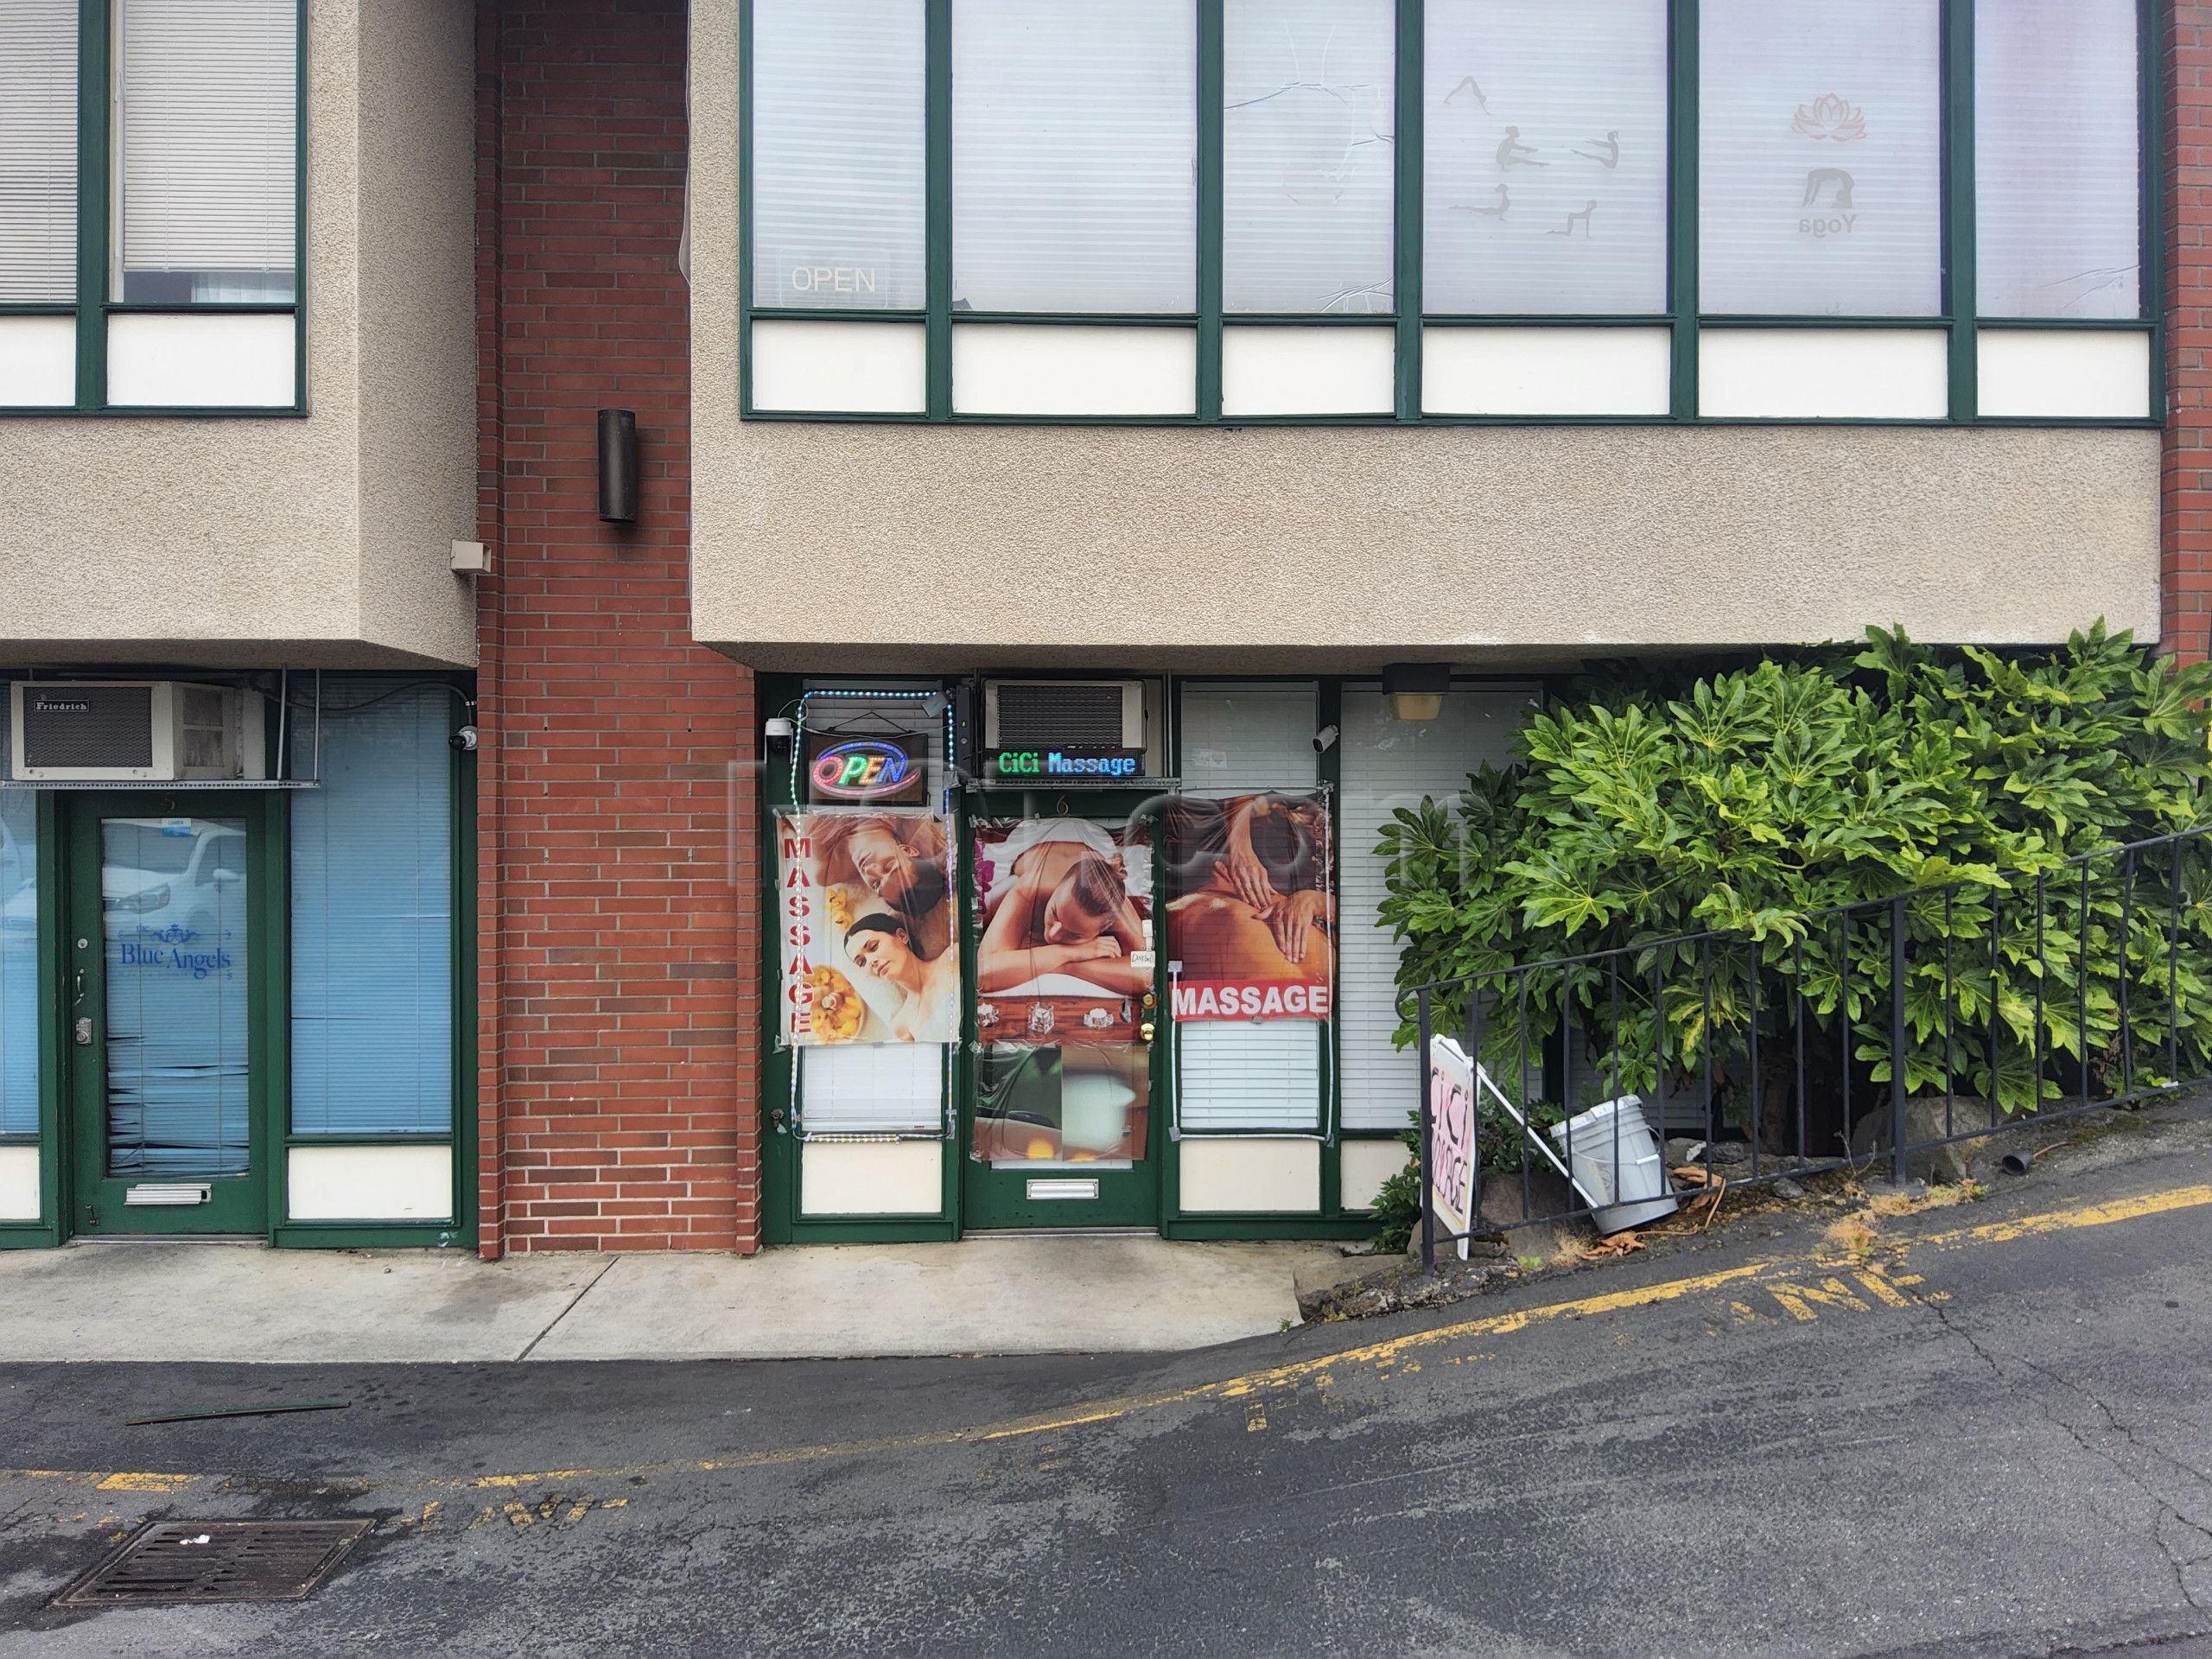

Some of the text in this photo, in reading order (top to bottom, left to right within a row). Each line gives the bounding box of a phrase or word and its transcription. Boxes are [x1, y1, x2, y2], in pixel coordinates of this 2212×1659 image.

[791, 265, 876, 292] OPEN
[35, 702, 87, 710] Friedrich
[813, 753, 904, 786] OPEN
[998, 752, 1135, 776] CiCi Massage
[1056, 794, 1069, 816] 6
[784, 837, 814, 1033] MASSAGE
[121, 943, 231, 980] Blue Angels
[1173, 985, 1329, 1015] MASSAGE
